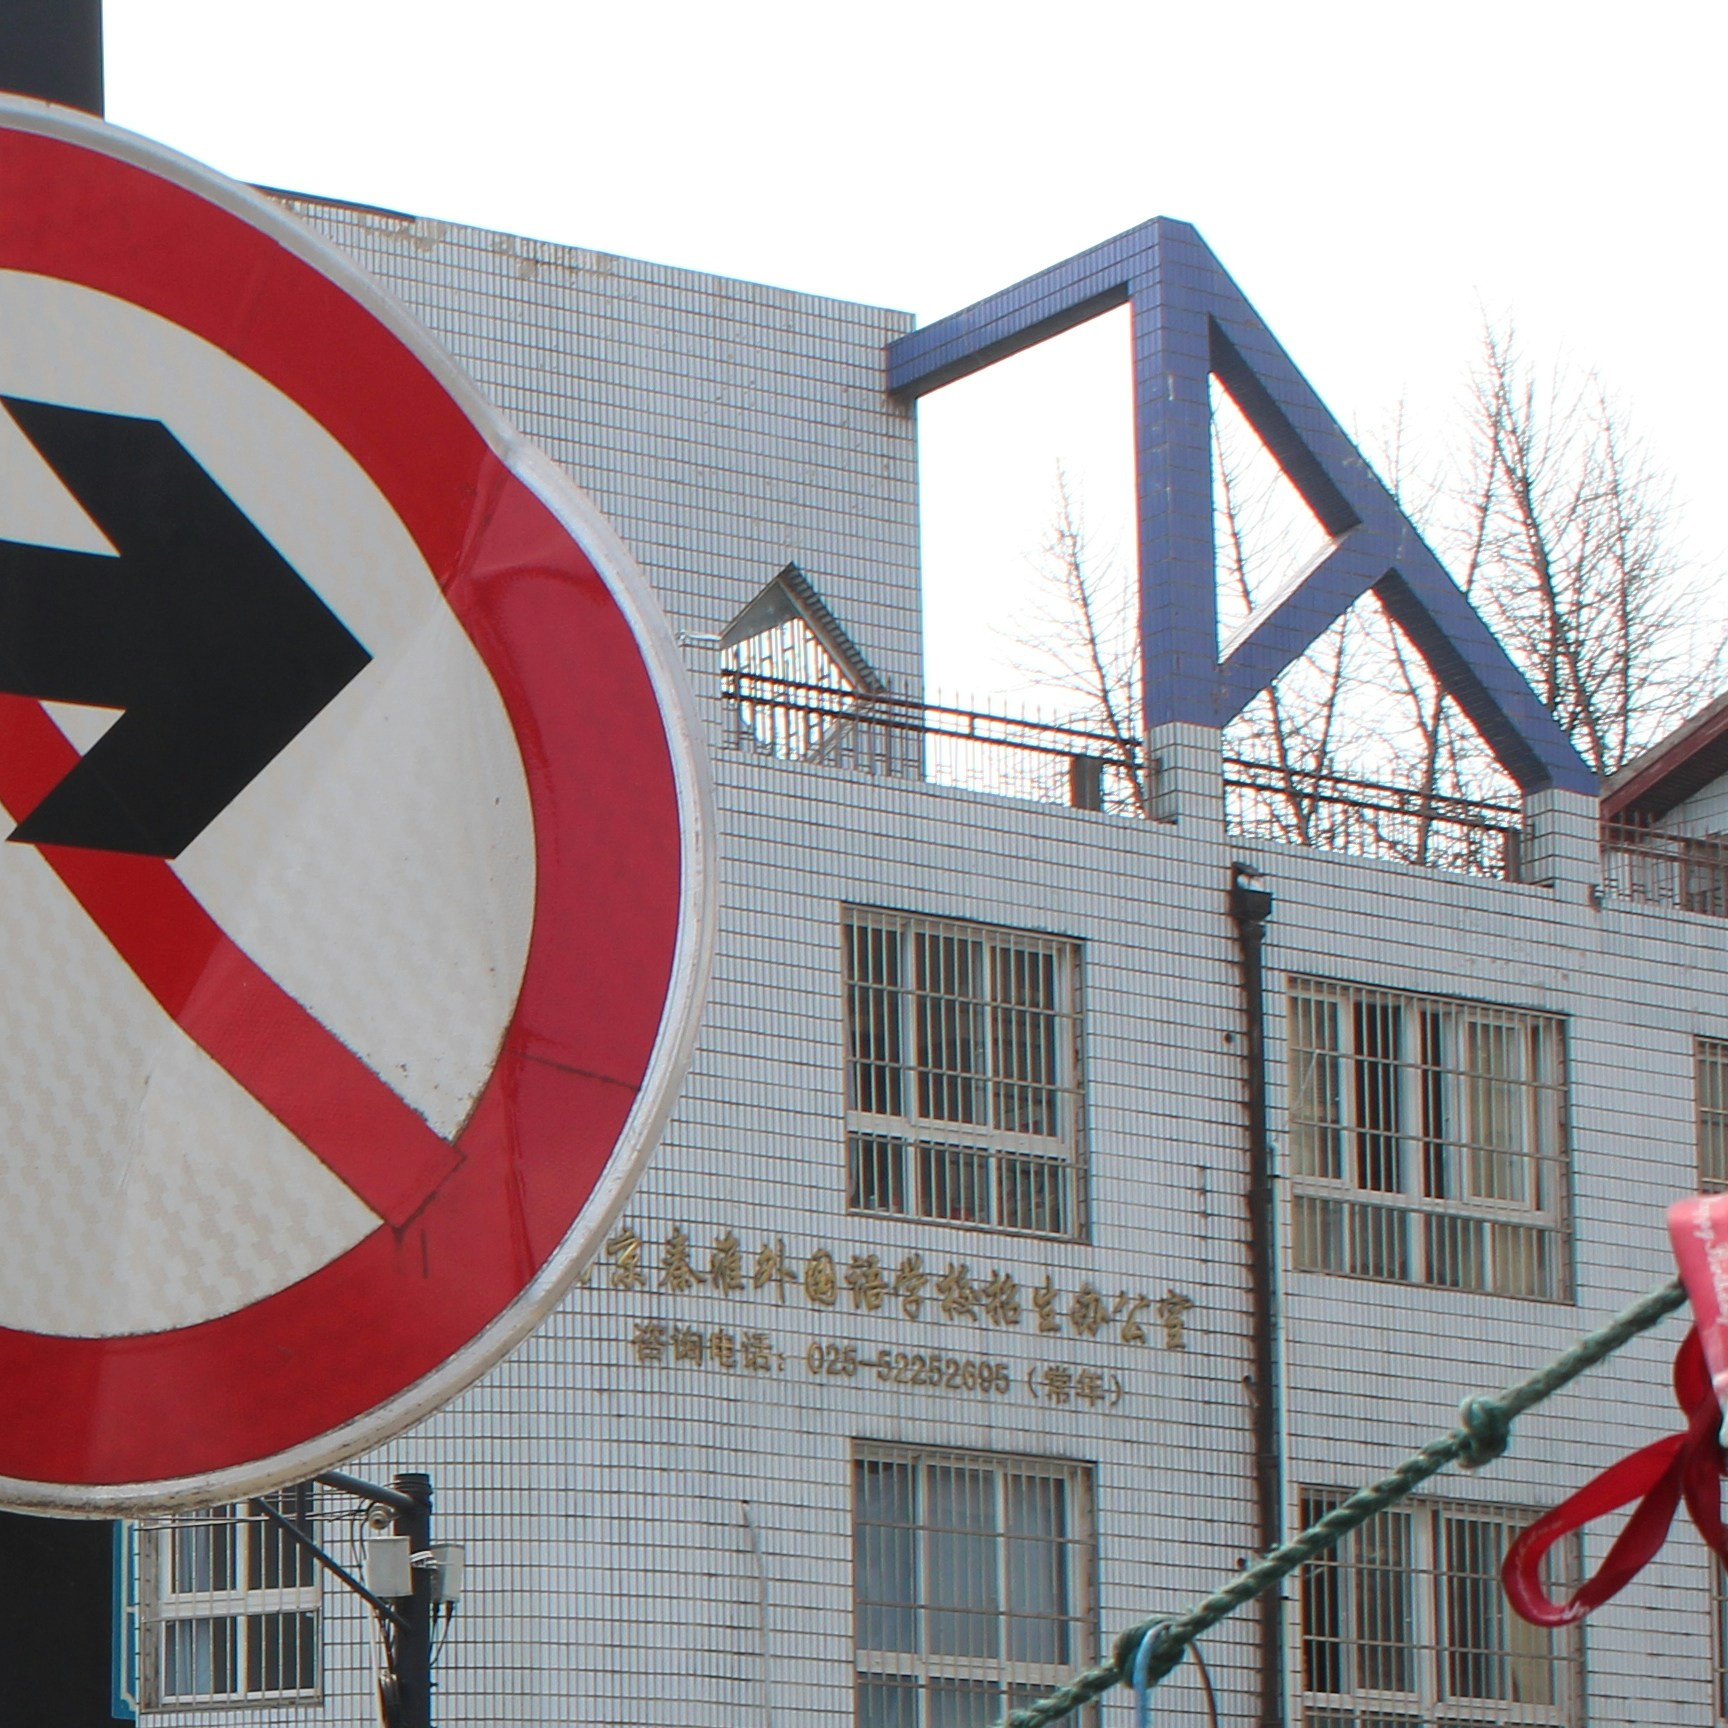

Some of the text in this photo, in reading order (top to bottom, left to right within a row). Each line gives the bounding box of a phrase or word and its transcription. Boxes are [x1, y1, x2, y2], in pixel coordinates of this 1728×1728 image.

[578, 1225, 1196, 1351] 京秦淮外国语学校招生办公室
